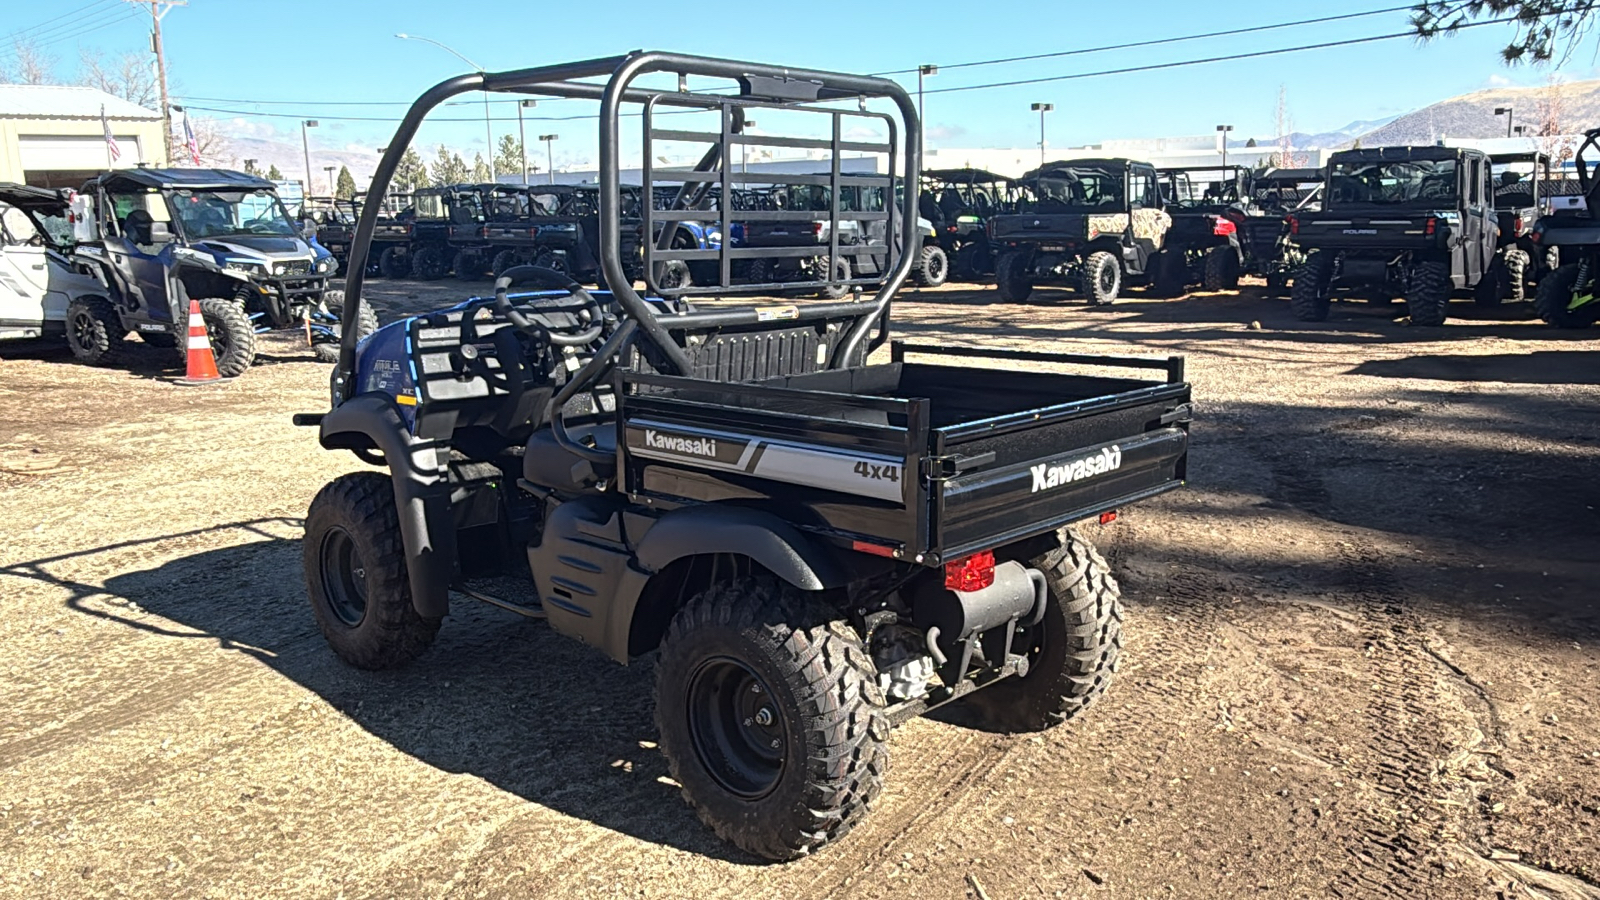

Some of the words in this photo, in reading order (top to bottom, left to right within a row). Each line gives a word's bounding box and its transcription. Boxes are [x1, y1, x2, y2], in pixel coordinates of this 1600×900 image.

[140, 323, 166, 332] POLARIS
[645, 429, 717, 457] Kawasaki
[853, 461, 899, 482] 4x4
[1030, 444, 1122, 493] Kawasaki
